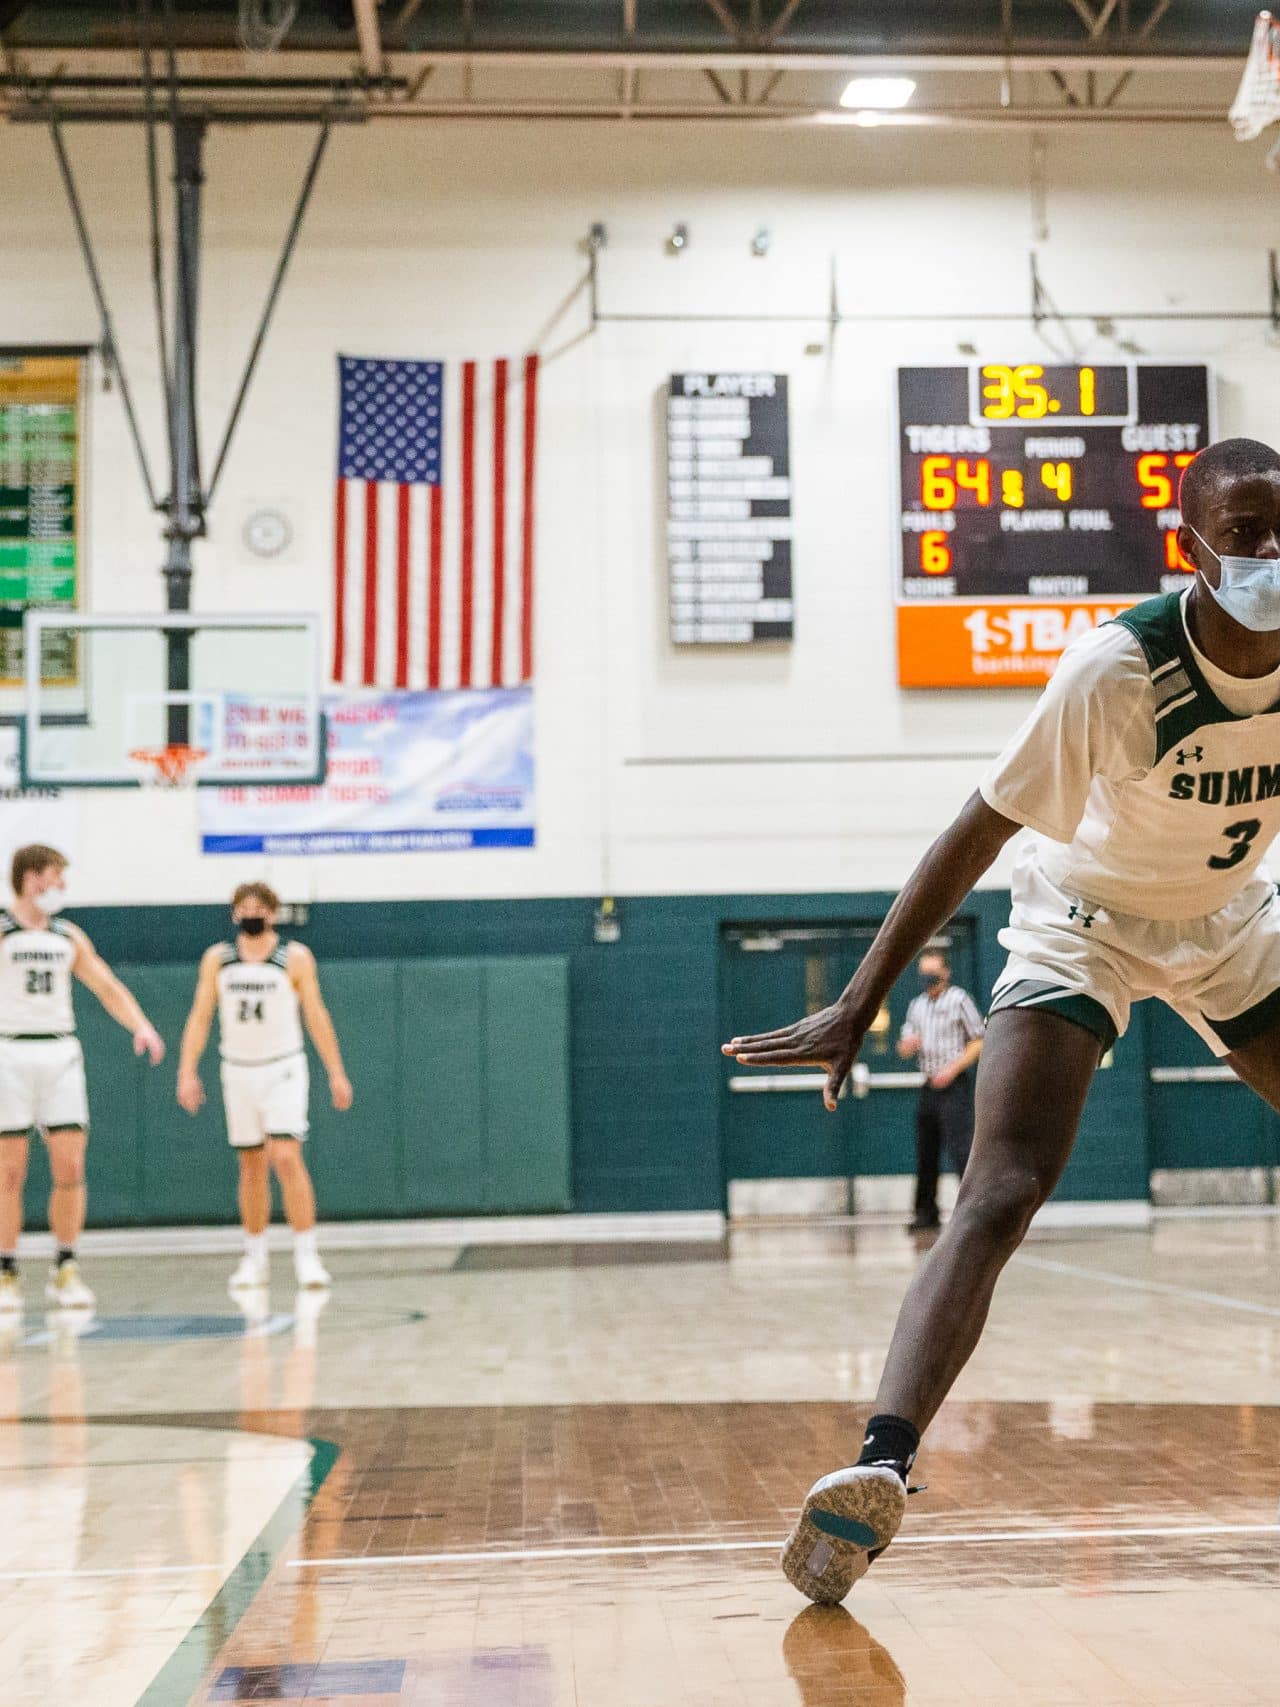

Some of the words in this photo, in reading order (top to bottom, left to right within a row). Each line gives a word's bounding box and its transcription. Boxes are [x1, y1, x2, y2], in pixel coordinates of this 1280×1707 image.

[683, 374, 776, 397] PLAYER
[982, 365, 1096, 419] 35.1
[905, 425, 991, 453] TIGERS
[1025, 437, 1085, 458] PERIOD
[1121, 424, 1200, 451] GUEST
[921, 454, 992, 511] 64
[1041, 462, 1073, 502] 4
[1136, 453, 1194, 509] 5
[920, 530, 952, 575] 6
[1206, 818, 1262, 870] 3
